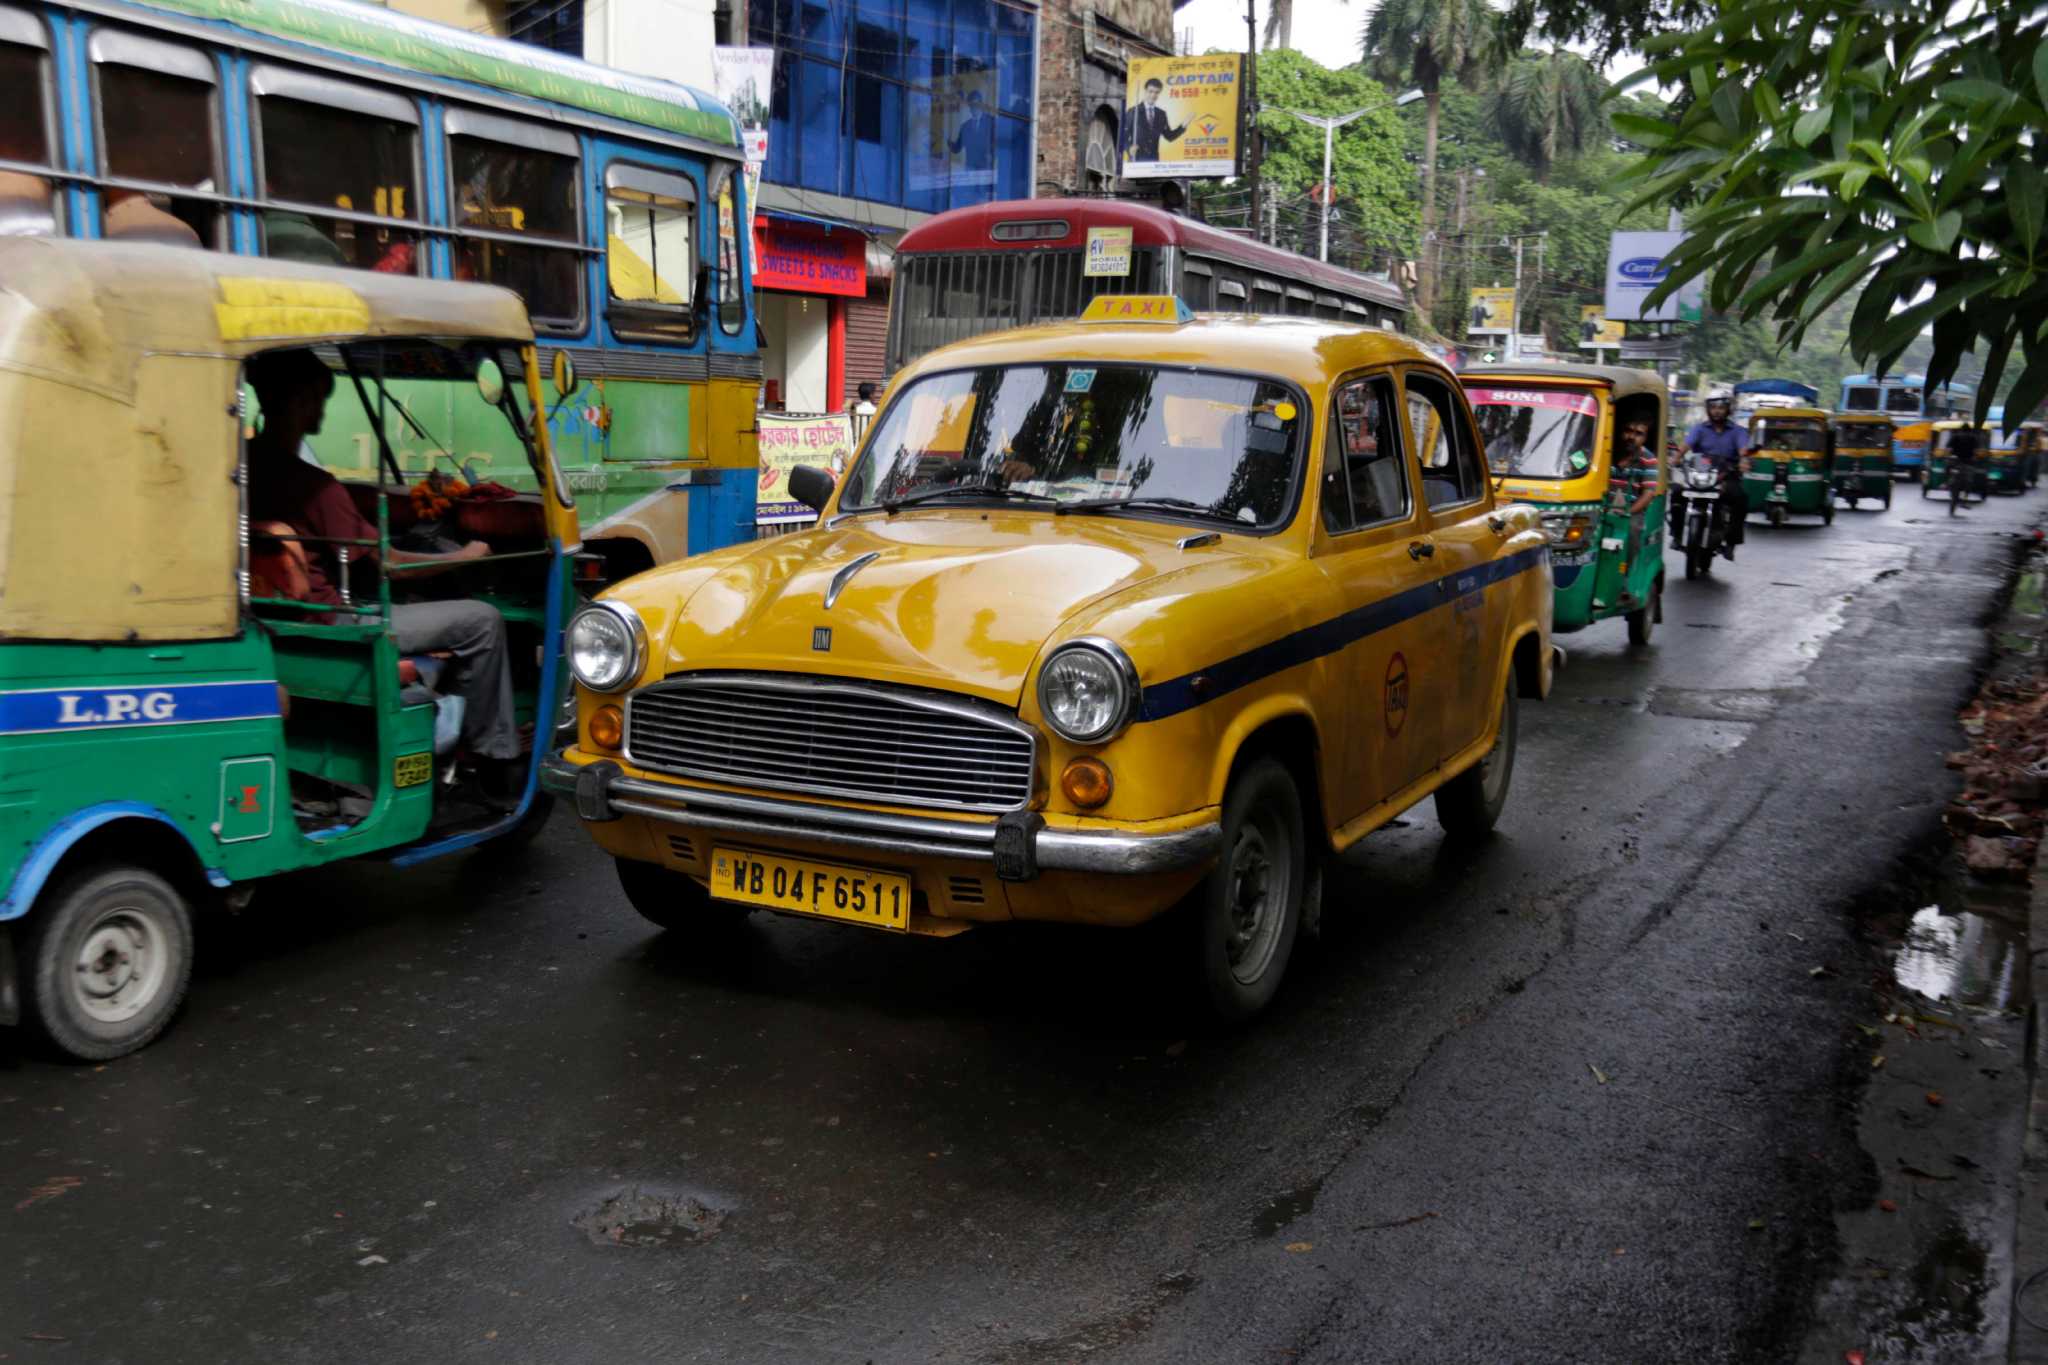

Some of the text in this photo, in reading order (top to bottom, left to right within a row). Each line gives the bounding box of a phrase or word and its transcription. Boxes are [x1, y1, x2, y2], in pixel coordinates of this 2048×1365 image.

[1167, 72, 1234, 86] CAPTAIN
[761, 255, 804, 276] SWEETS
[1103, 300, 1168, 315] TAXI
[1491, 390, 1545, 403] SONA
[58, 692, 177, 723] L.P.G
